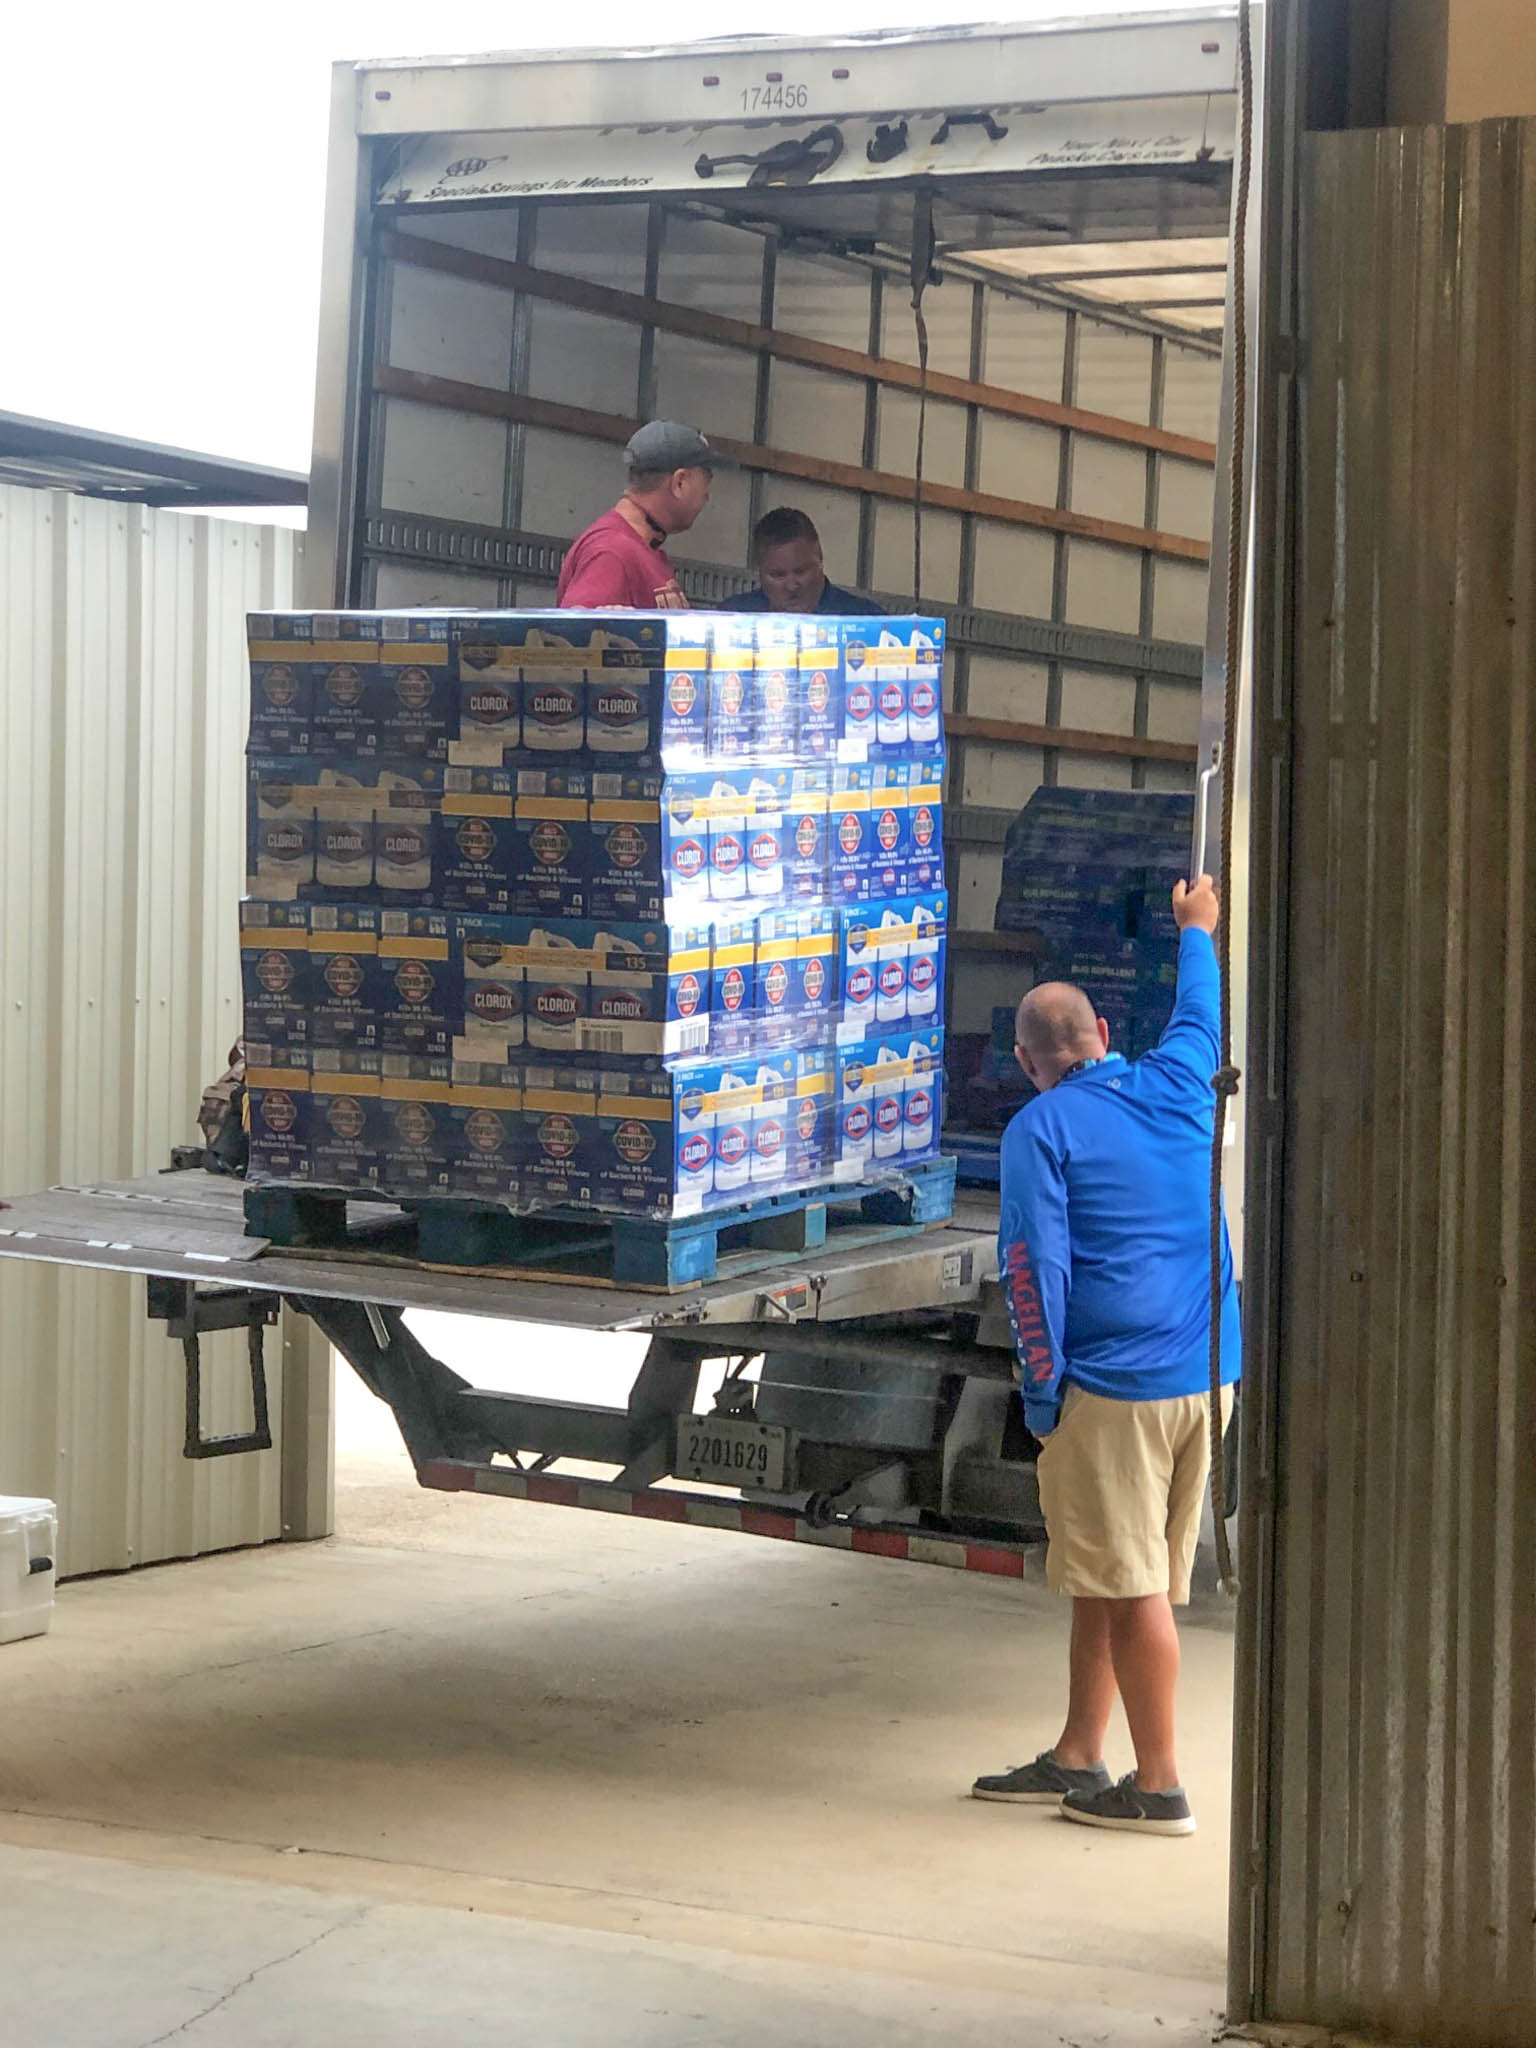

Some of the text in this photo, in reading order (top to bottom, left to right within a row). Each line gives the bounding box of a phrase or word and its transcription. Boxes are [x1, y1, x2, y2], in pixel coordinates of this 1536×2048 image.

[740, 83, 808, 113] 174456
[425, 174, 655, 200] Special Savings for Members
[470, 696, 509, 711] CLOROX
[534, 697, 573, 713] CLOROX
[598, 698, 638, 714] CLOROX
[850, 695, 870, 710] CLOROX
[882, 694, 902, 708] CLOROX
[913, 692, 932, 707] CLOROX
[267, 833, 303, 848] CLOROX
[326, 836, 362, 851] CLOROX
[385, 838, 420, 852] CLOROX
[677, 850, 701, 866] CLOROX
[715, 846, 739, 861] CLOROX
[752, 843, 776, 859] CLOROX
[625, 957, 646, 969] 135
[882, 970, 903, 986] CLOROX
[912, 965, 933, 981] CLOROX
[850, 976, 871, 993] CLOROX
[474, 993, 513, 1009] CLOROX
[537, 997, 576, 1013] CLOROX
[602, 1001, 641, 1017] CLOROX
[879, 1107, 899, 1123] CLOROX
[908, 1100, 929, 1117] CLOROX
[847, 1113, 868, 1131] CLOROX
[616, 1135, 654, 1149] COVID-19
[721, 1137, 745, 1153] CLOROX
[757, 1130, 781, 1146] CLOROX
[684, 1144, 708, 1161] CLOROX
[1007, 1241, 1054, 1381] MAGELLAN
[688, 1435, 768, 1472] 2201629
